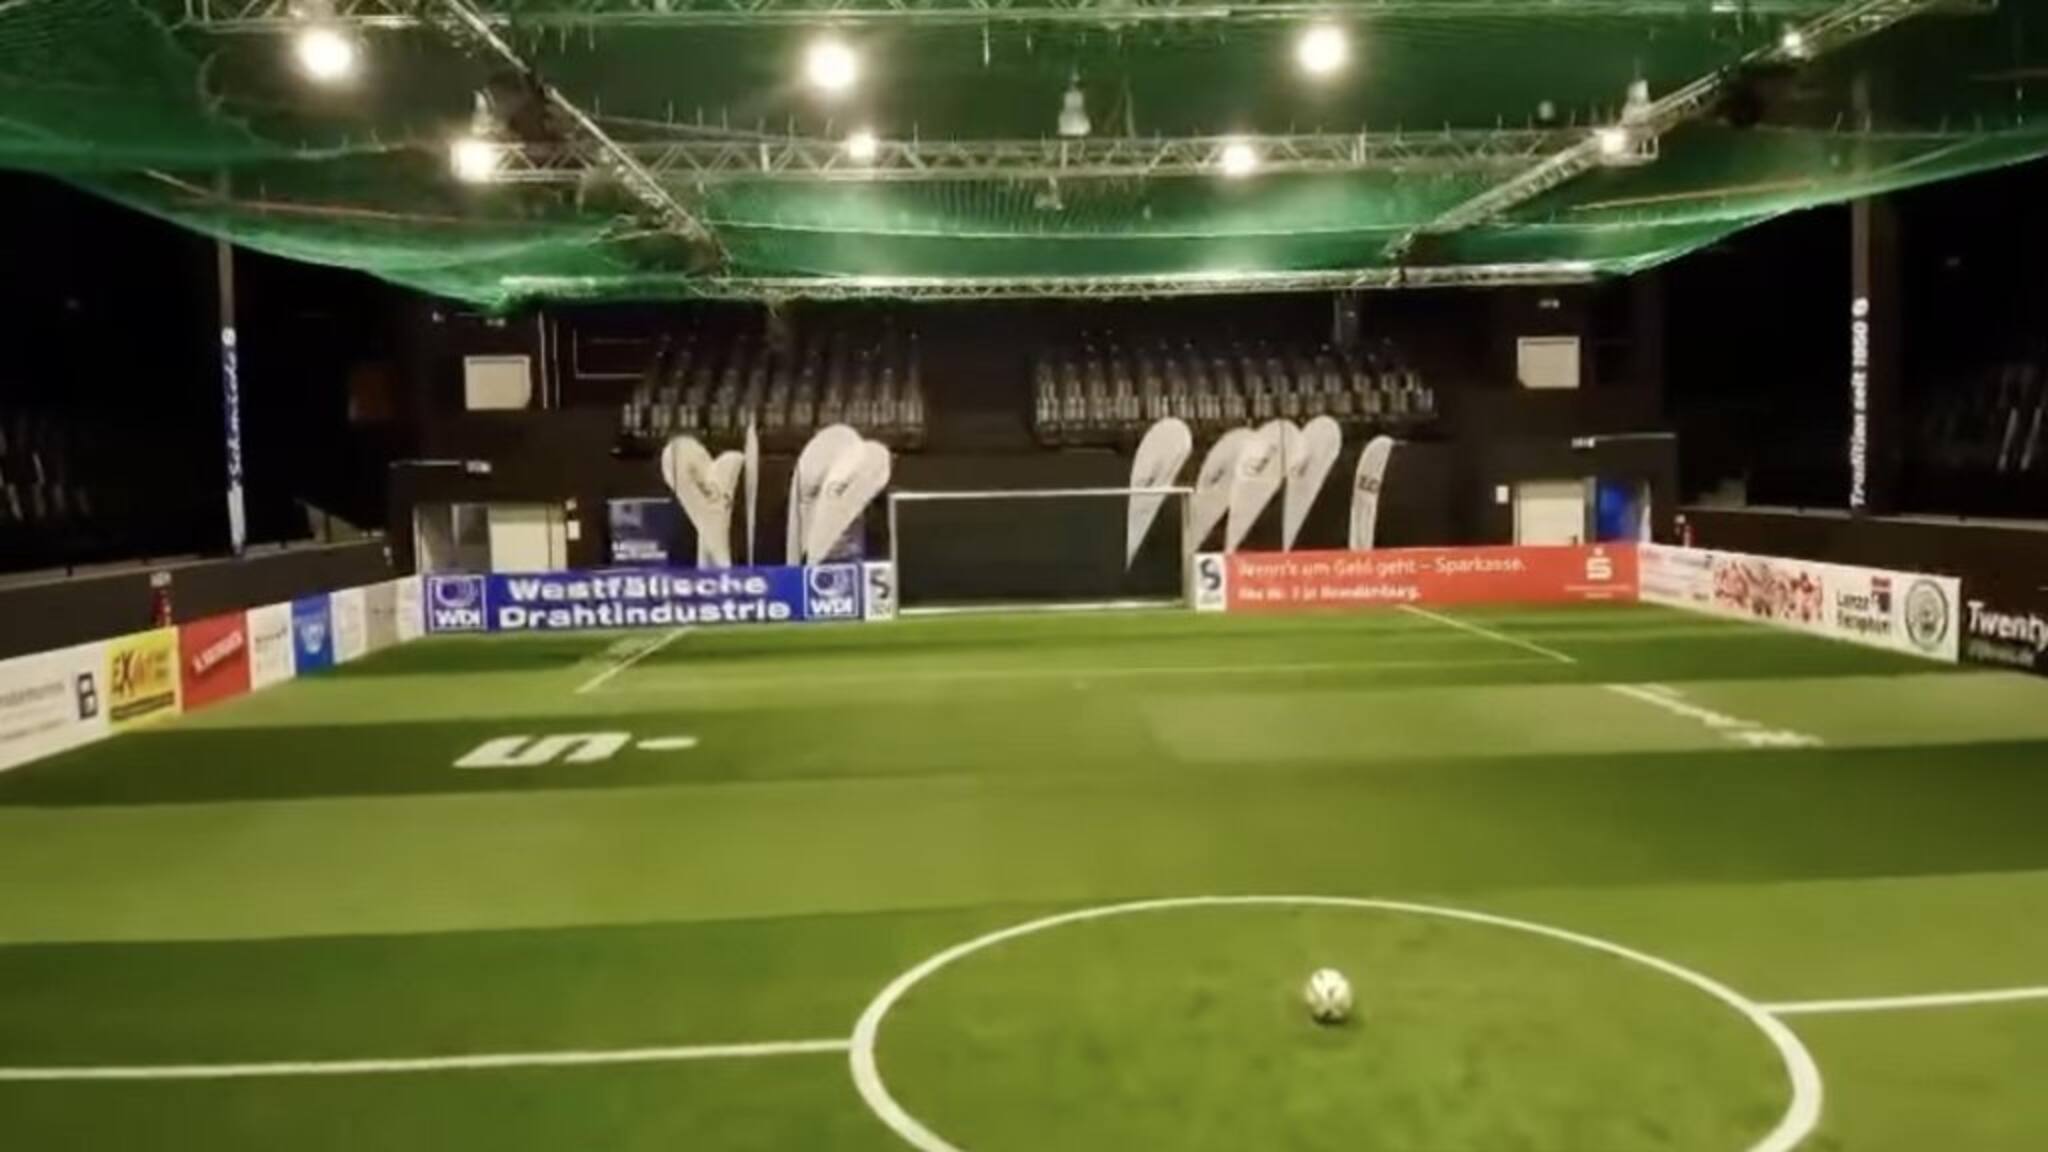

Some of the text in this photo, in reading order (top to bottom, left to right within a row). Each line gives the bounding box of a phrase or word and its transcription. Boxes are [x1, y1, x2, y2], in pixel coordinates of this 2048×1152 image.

[1376, 557, 1416, 579] geht
[507, 572, 769, 602] Westfälische
[499, 599, 792, 629] Drahtindustrie
[810, 597, 853, 613] WDI
[434, 608, 481, 628] WDI
